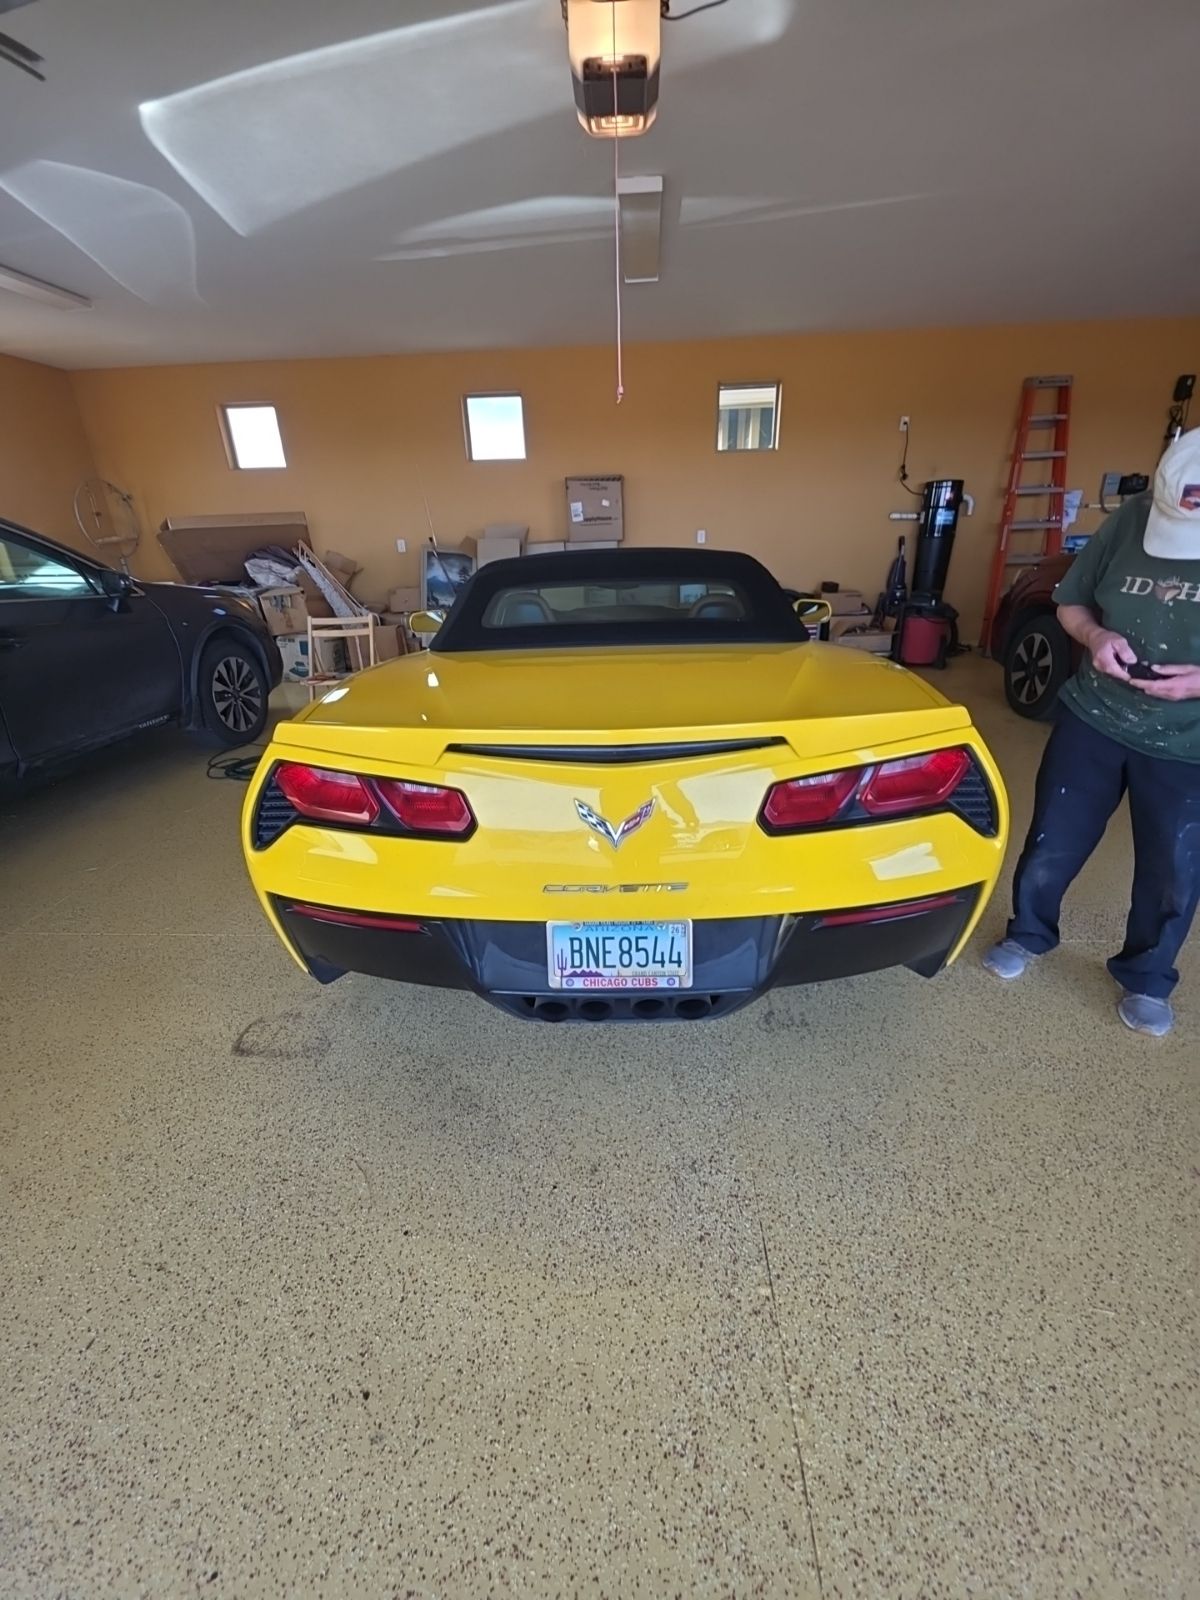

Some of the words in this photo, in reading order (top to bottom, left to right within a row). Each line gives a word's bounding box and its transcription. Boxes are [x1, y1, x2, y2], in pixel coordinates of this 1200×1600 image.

[543, 884, 689, 893] CORVETTE
[570, 936, 682, 968] BNE8544
[583, 977, 628, 987] CHICAGO
[631, 977, 658, 987] CUBS
